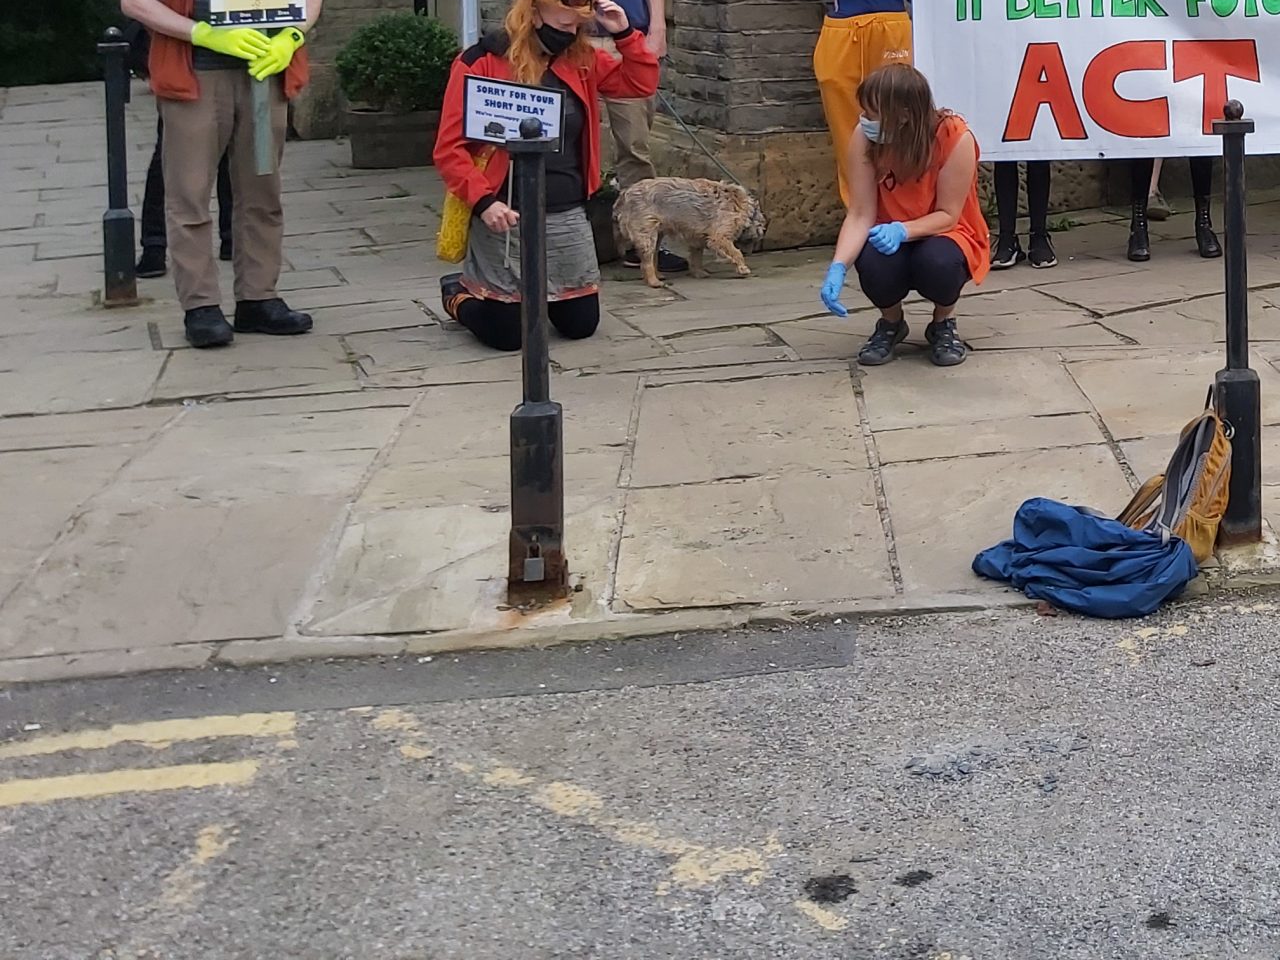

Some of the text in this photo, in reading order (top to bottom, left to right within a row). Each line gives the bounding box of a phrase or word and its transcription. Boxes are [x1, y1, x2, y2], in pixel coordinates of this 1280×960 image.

[476, 85, 555, 105] SORRY FOR YOUR
[1001, 38, 1261, 142] ACT
[484, 99, 545, 116] SHORT DELAY
